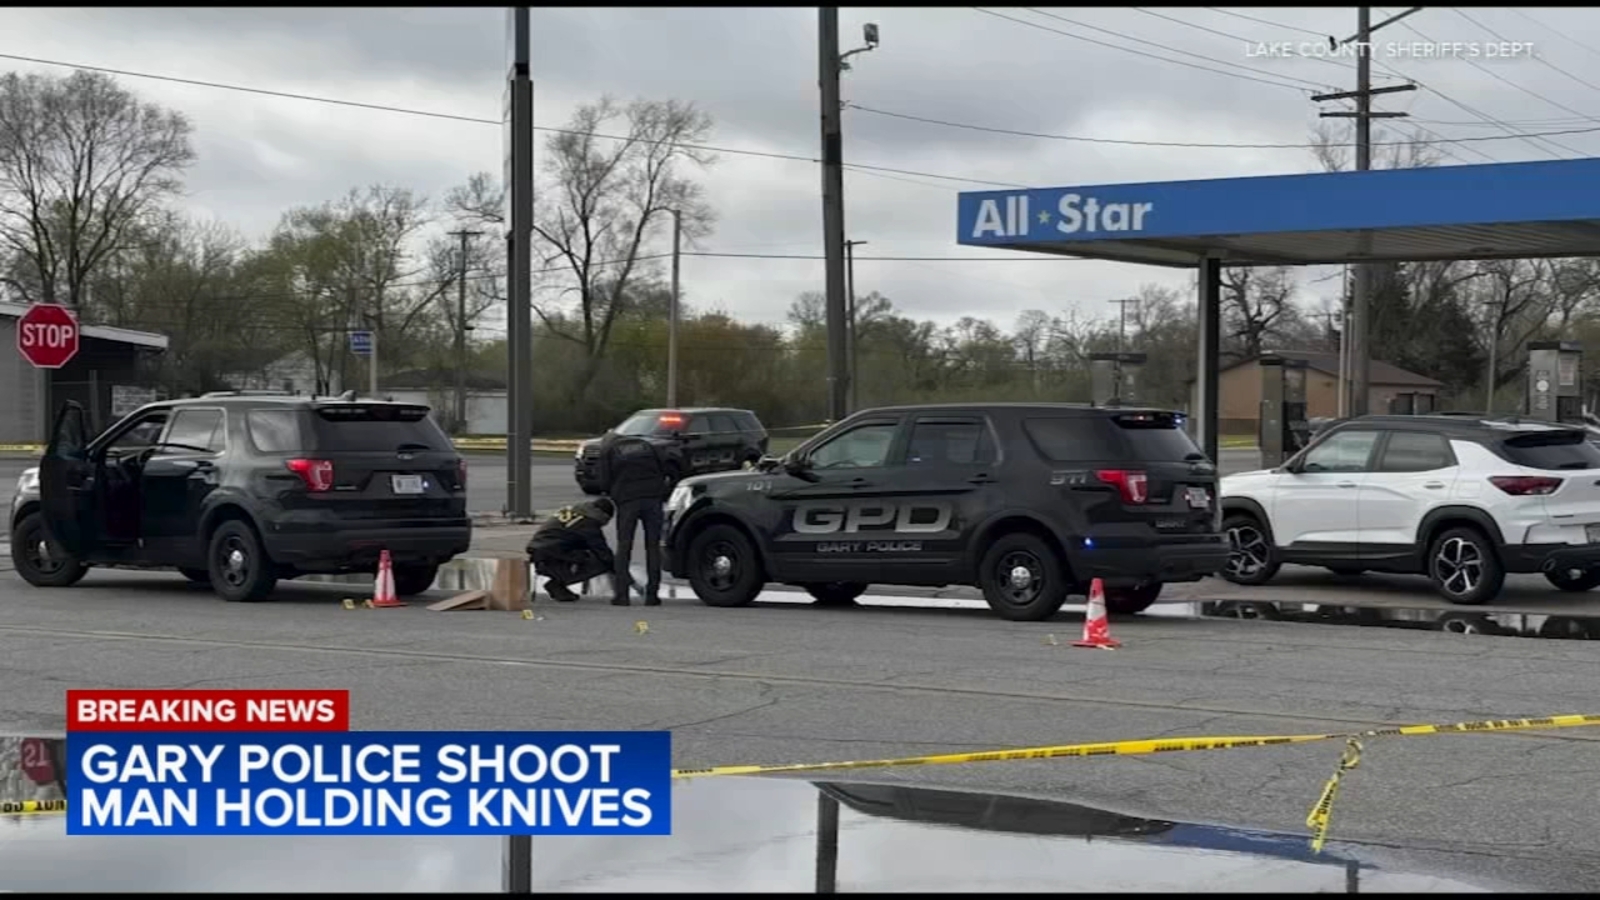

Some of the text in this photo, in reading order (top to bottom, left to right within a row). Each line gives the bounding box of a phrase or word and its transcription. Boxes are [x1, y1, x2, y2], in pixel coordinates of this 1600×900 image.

[972, 193, 1152, 238] All Star
[21, 323, 74, 350] STOP
[792, 500, 953, 534] GPD
[816, 541, 923, 553] GARY POLICE
